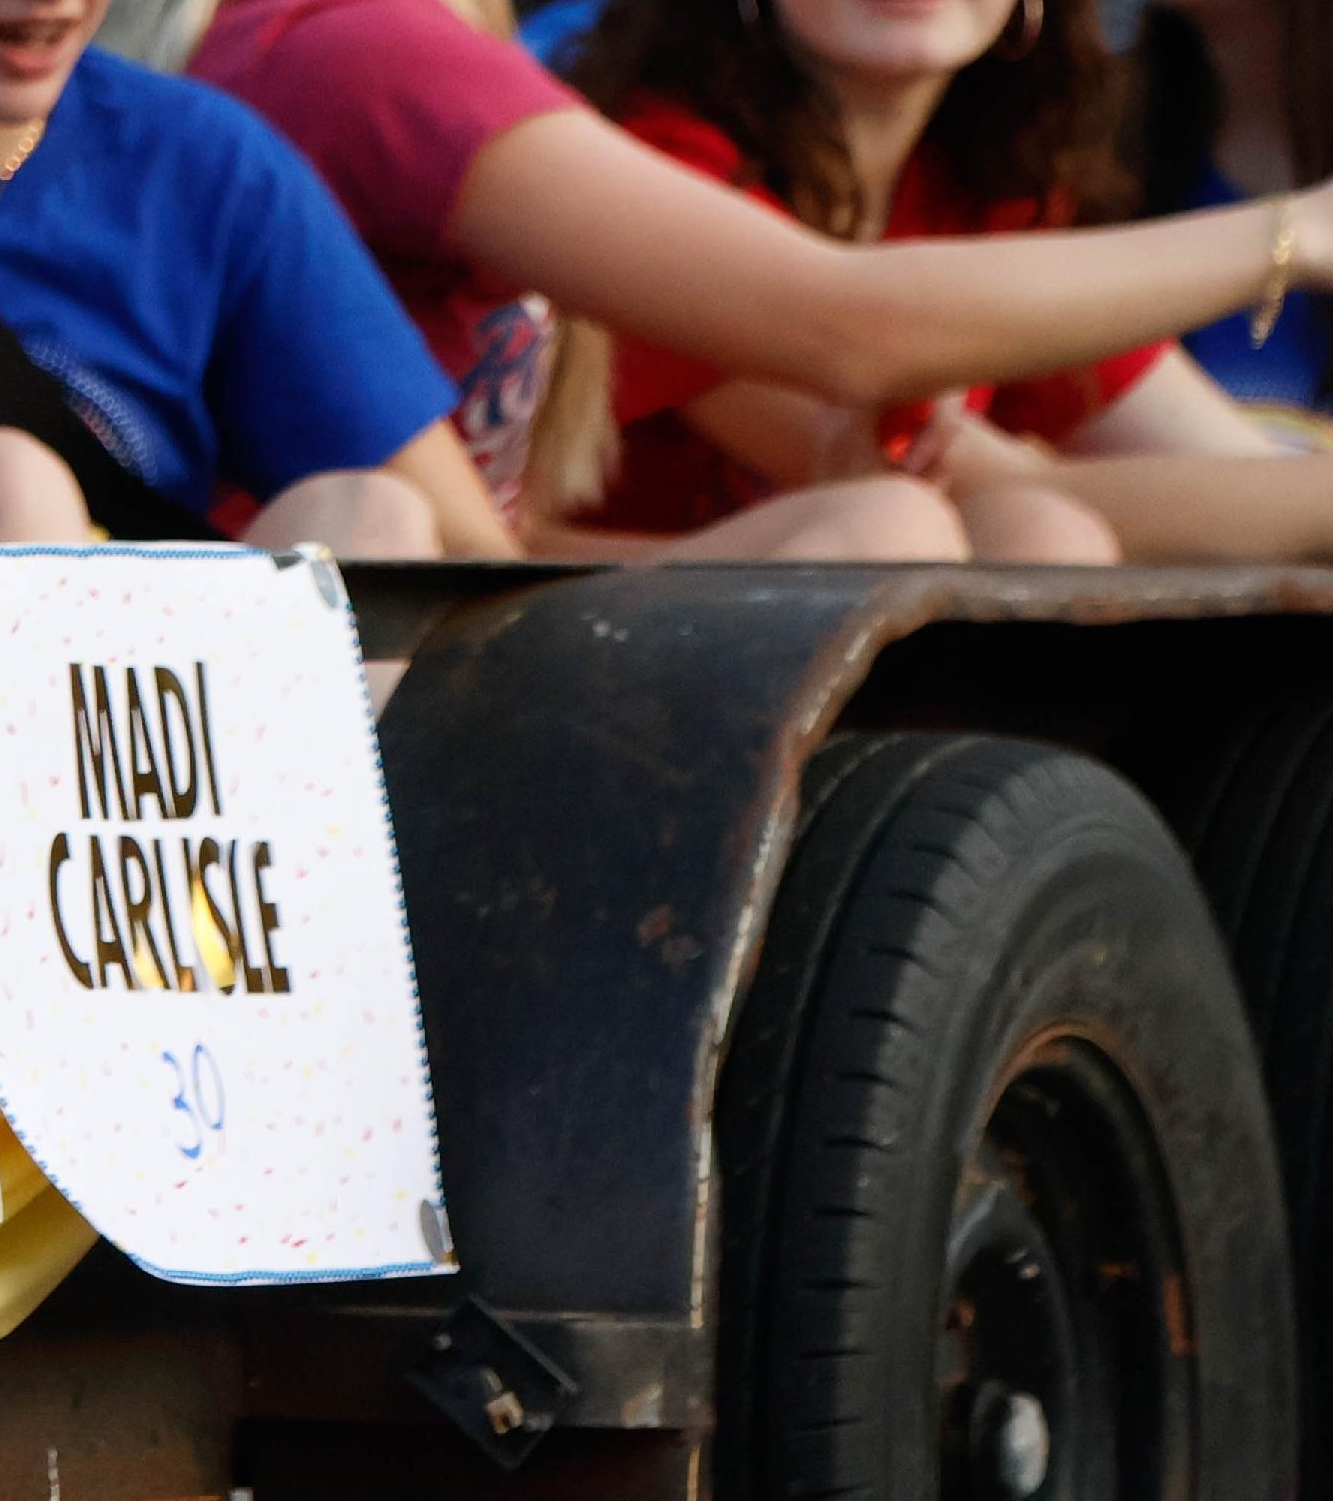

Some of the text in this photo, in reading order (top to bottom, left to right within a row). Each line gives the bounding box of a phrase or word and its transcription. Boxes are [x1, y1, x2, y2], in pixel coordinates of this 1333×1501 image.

[68, 660, 222, 821] MADI
[47, 832, 291, 996] CARLISLE
[161, 1041, 226, 1161] 30
